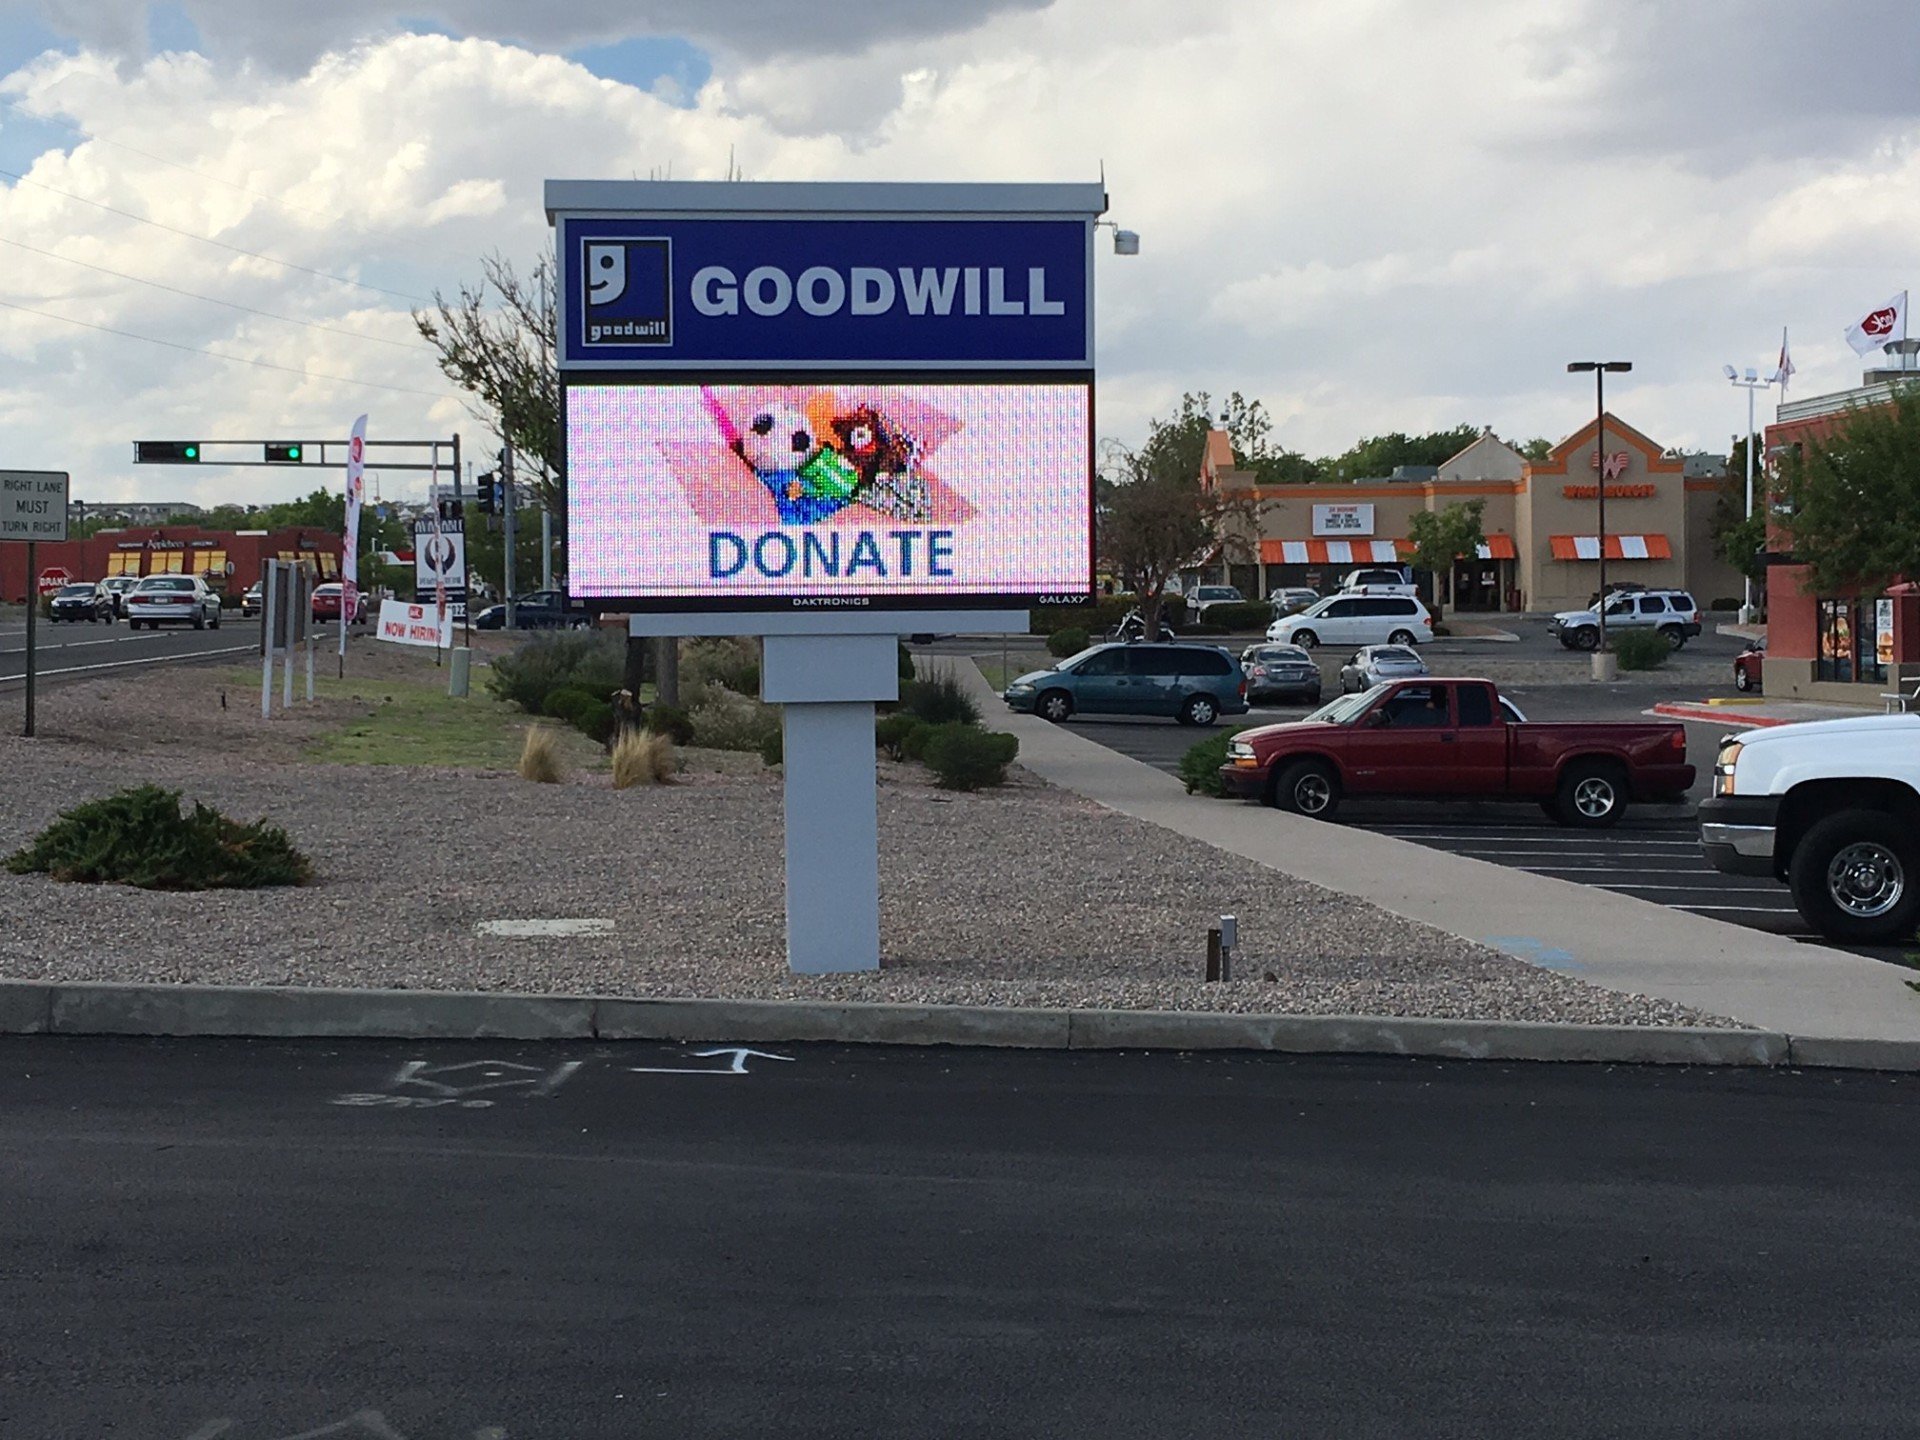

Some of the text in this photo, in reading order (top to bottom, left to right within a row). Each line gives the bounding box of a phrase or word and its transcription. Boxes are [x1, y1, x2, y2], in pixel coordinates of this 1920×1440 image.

[690, 266, 1065, 316] GOODWILL
[591, 321, 666, 342] goodwill
[4, 480, 63, 493] RIGHT LANE
[1563, 484, 1655, 499] WHATBURGER
[16, 500, 49, 514] MUST
[2, 521, 61, 533] TURN RIGHT
[415, 519, 463, 533] AVAABLE
[709, 531, 953, 578] DONATE
[792, 595, 1086, 606] DAKTRONICS GALAXY
[385, 621, 406, 637] NOW
